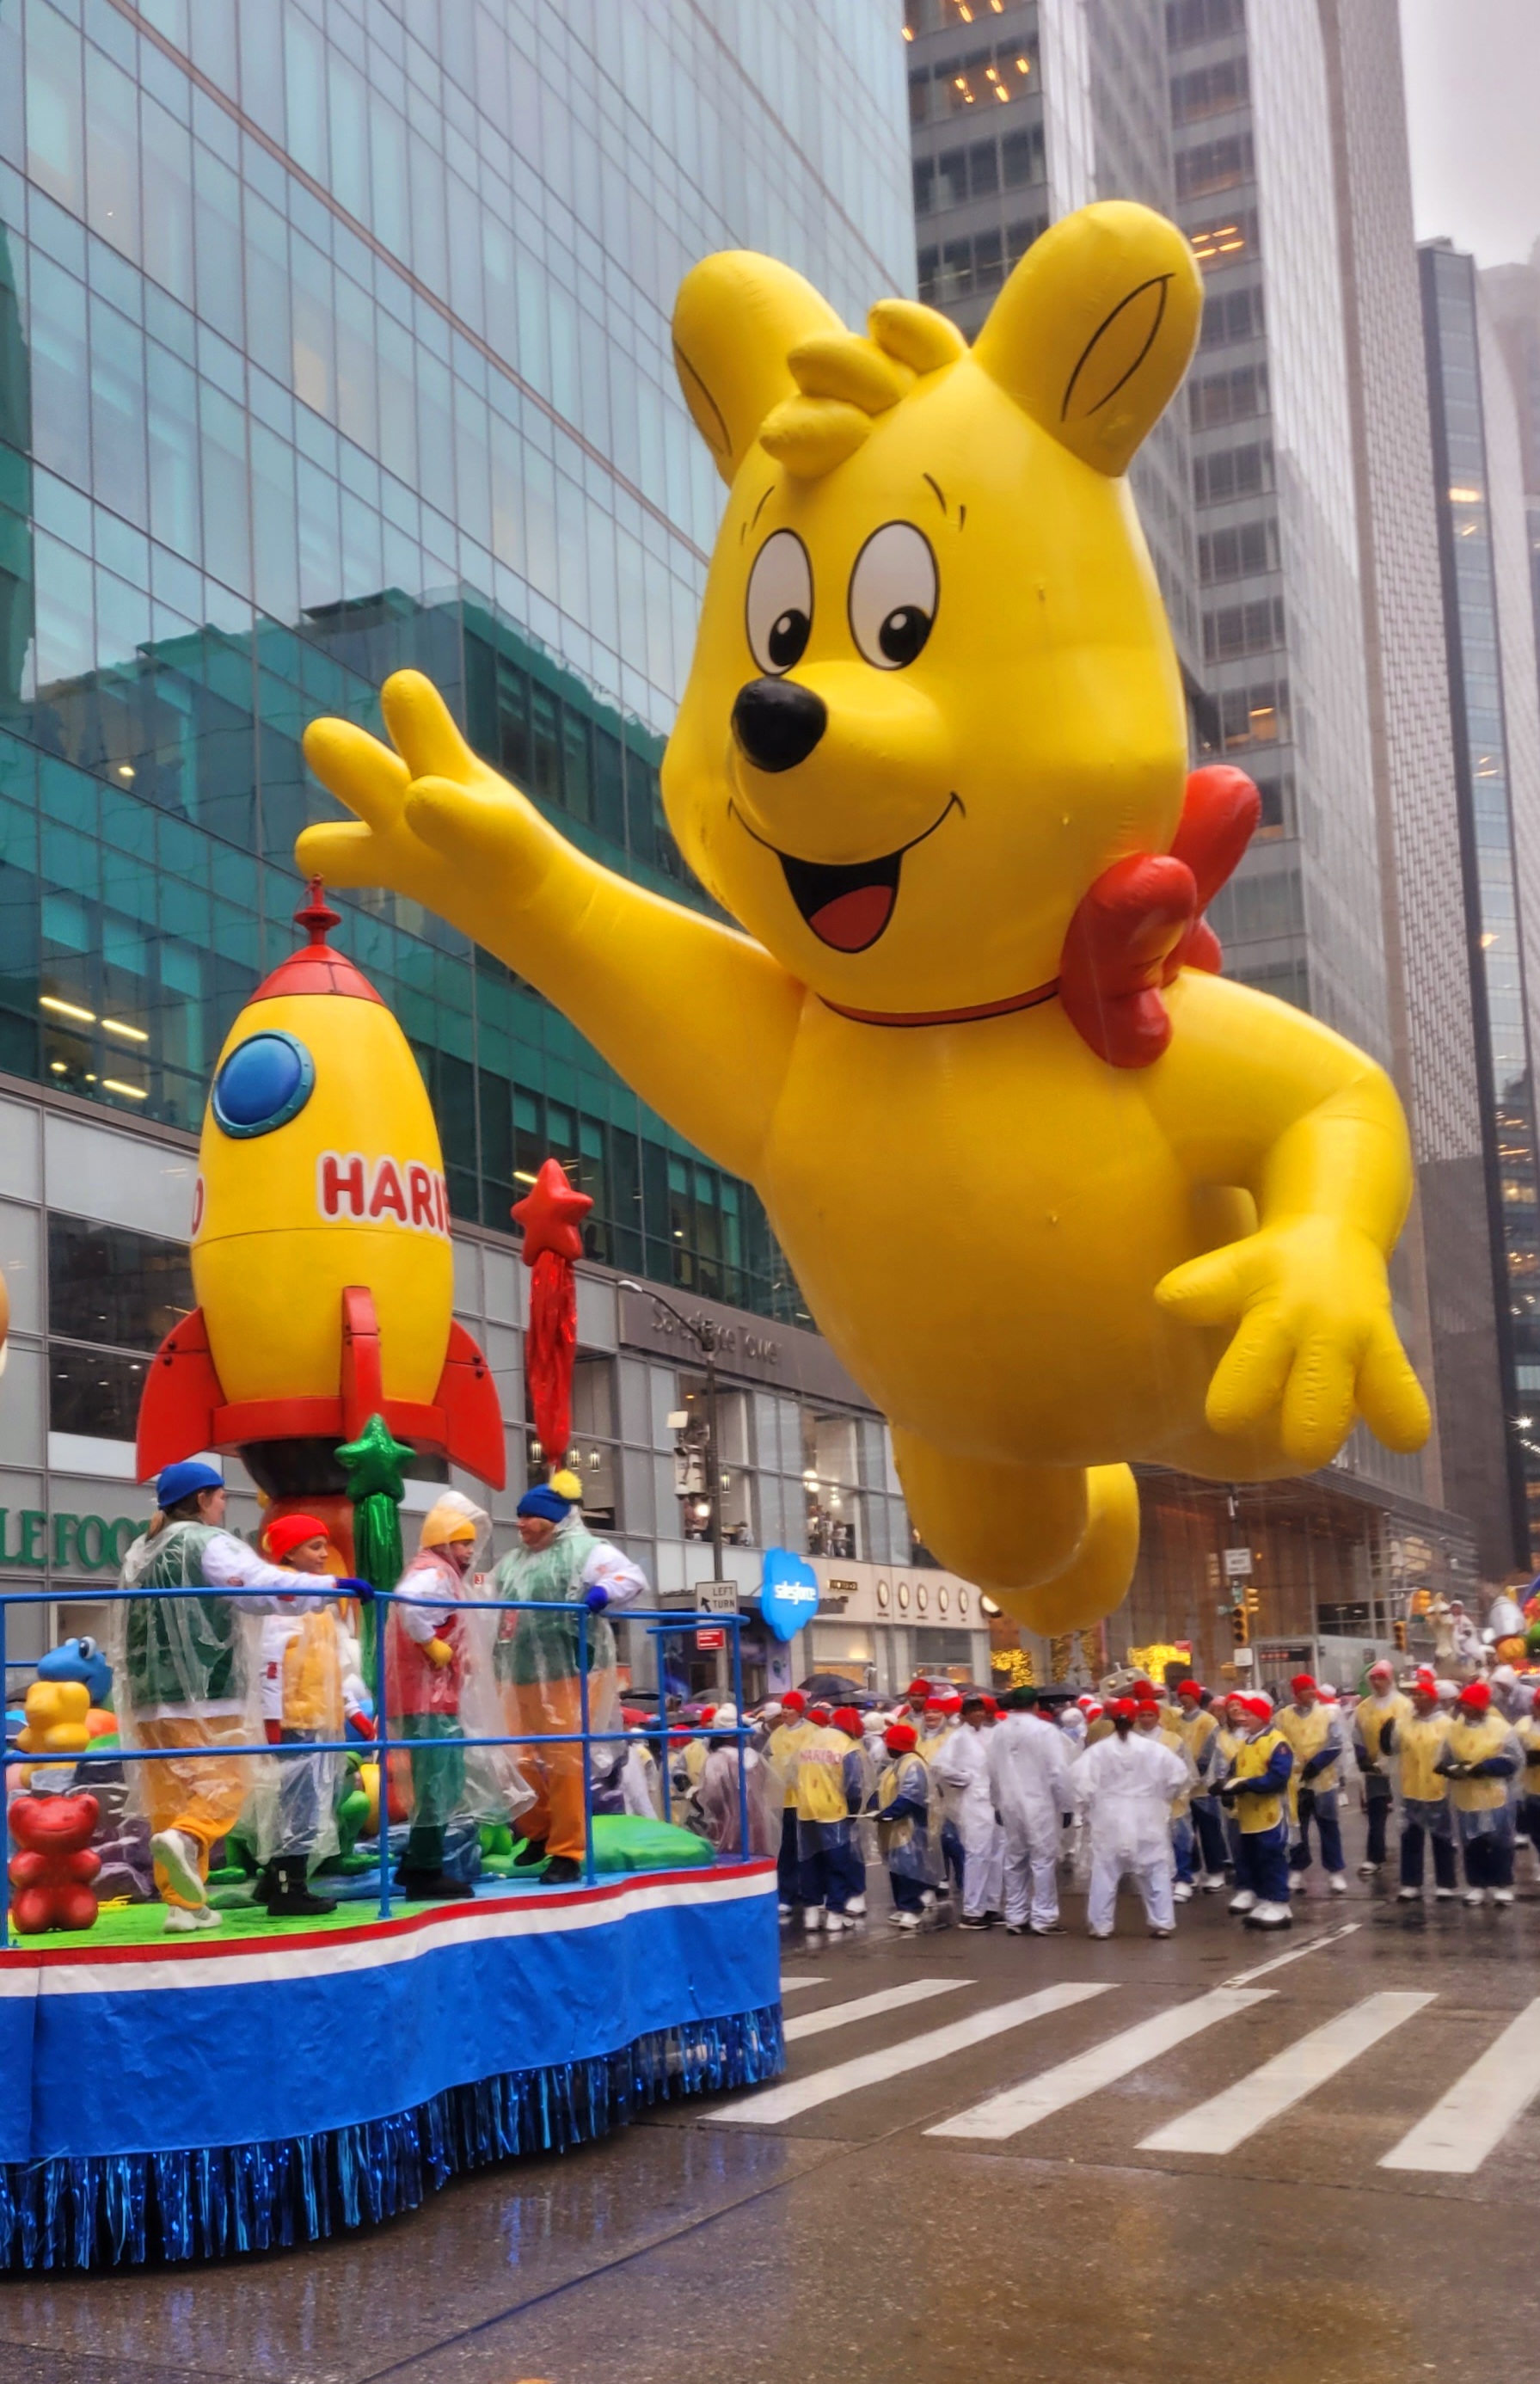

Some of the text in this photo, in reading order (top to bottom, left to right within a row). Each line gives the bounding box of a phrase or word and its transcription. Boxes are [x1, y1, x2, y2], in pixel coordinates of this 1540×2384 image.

[322, 1155, 452, 1238] HARI
[738, 1324, 784, 1366] Tower
[53, 1513, 150, 1570] FOO
[712, 1599, 735, 1609] TURN
[713, 1586, 733, 1597] LEFT
